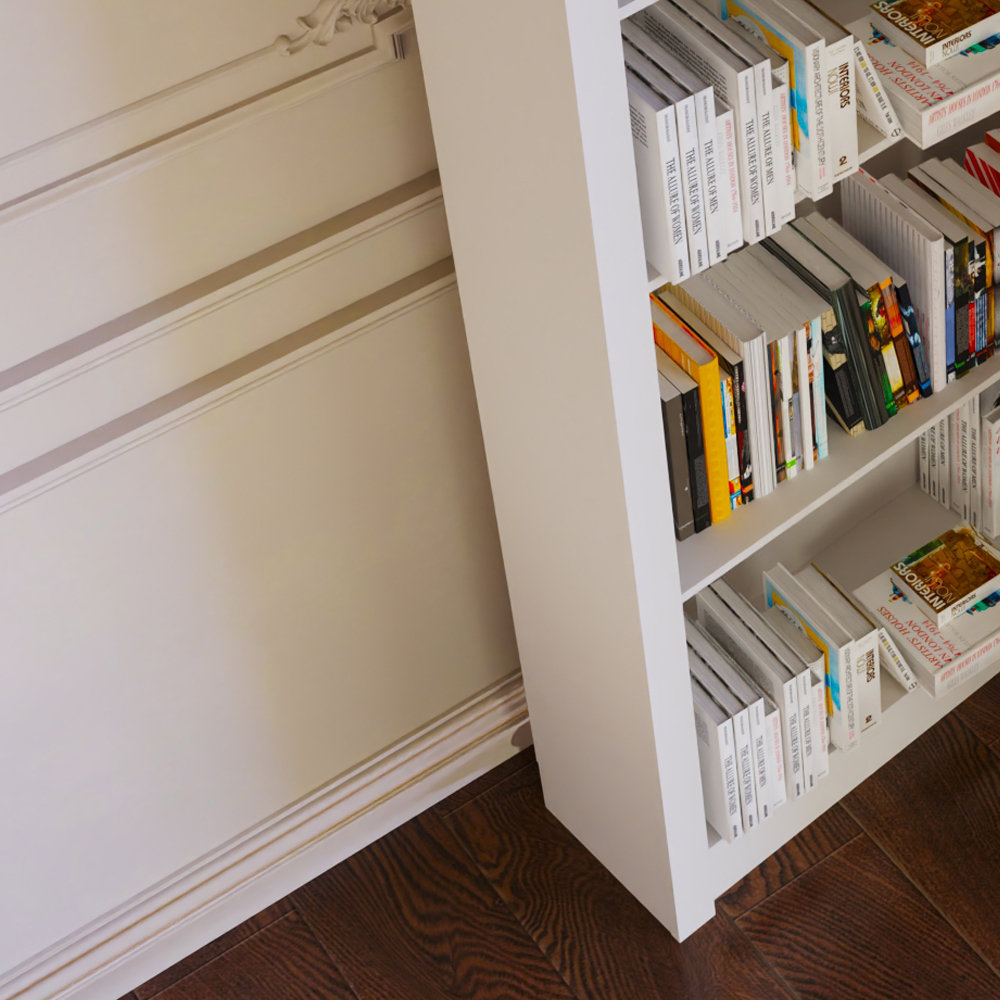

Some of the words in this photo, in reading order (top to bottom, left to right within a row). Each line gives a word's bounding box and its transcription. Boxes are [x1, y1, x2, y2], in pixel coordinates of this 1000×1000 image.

[874, 0, 936, 46] INTERIORS
[942, 31, 972, 50] INTERIORS
[838, 62, 851, 109] INTERIORS
[888, 60, 930, 92] LONDON
[894, 562, 946, 610] INTERIORS
